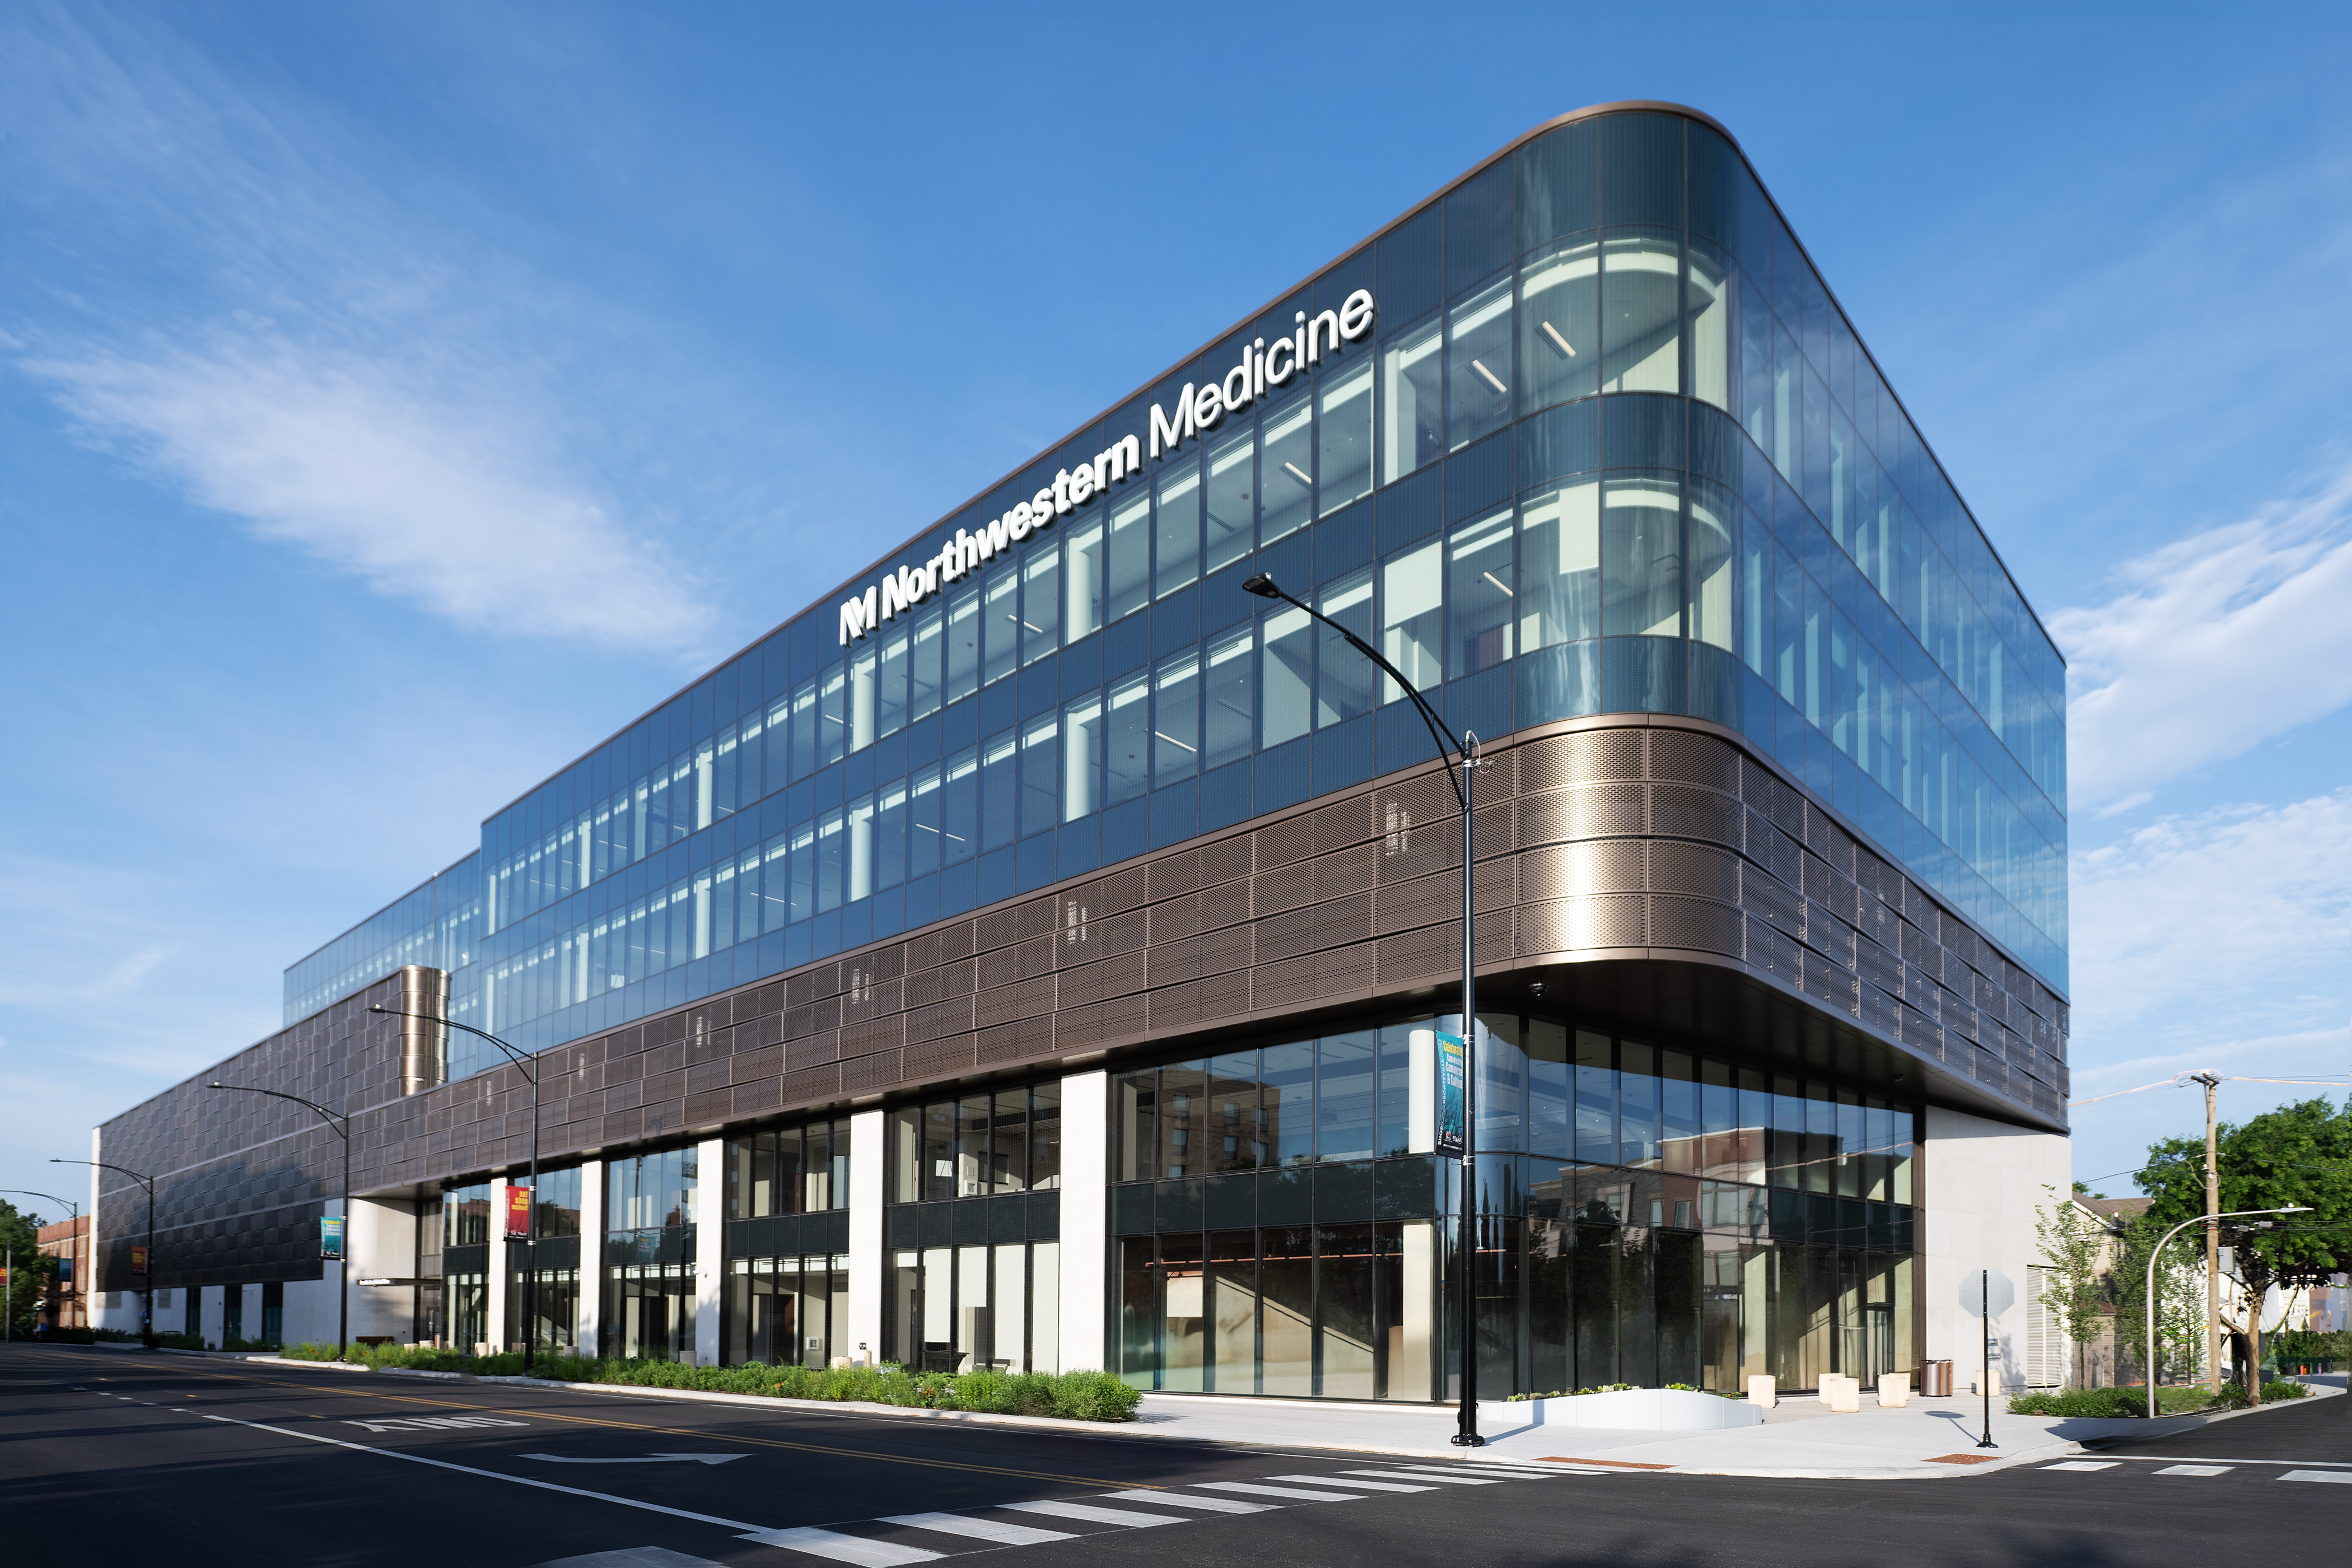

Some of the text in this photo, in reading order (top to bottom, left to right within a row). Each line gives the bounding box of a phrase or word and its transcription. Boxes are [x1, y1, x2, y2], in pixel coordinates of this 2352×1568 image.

[882, 434, 1139, 620] Northwestern
[1150, 289, 1374, 458] Medicine
[1443, 1040, 1462, 1057] Celebrate
[1446, 1053, 1462, 1067] Community
[1445, 1062, 1462, 1076] Commerce
[1447, 1073, 1462, 1089] & Culture
[515, 1196, 528, 1205] shop
[341, 1417, 530, 1432] ONLY
